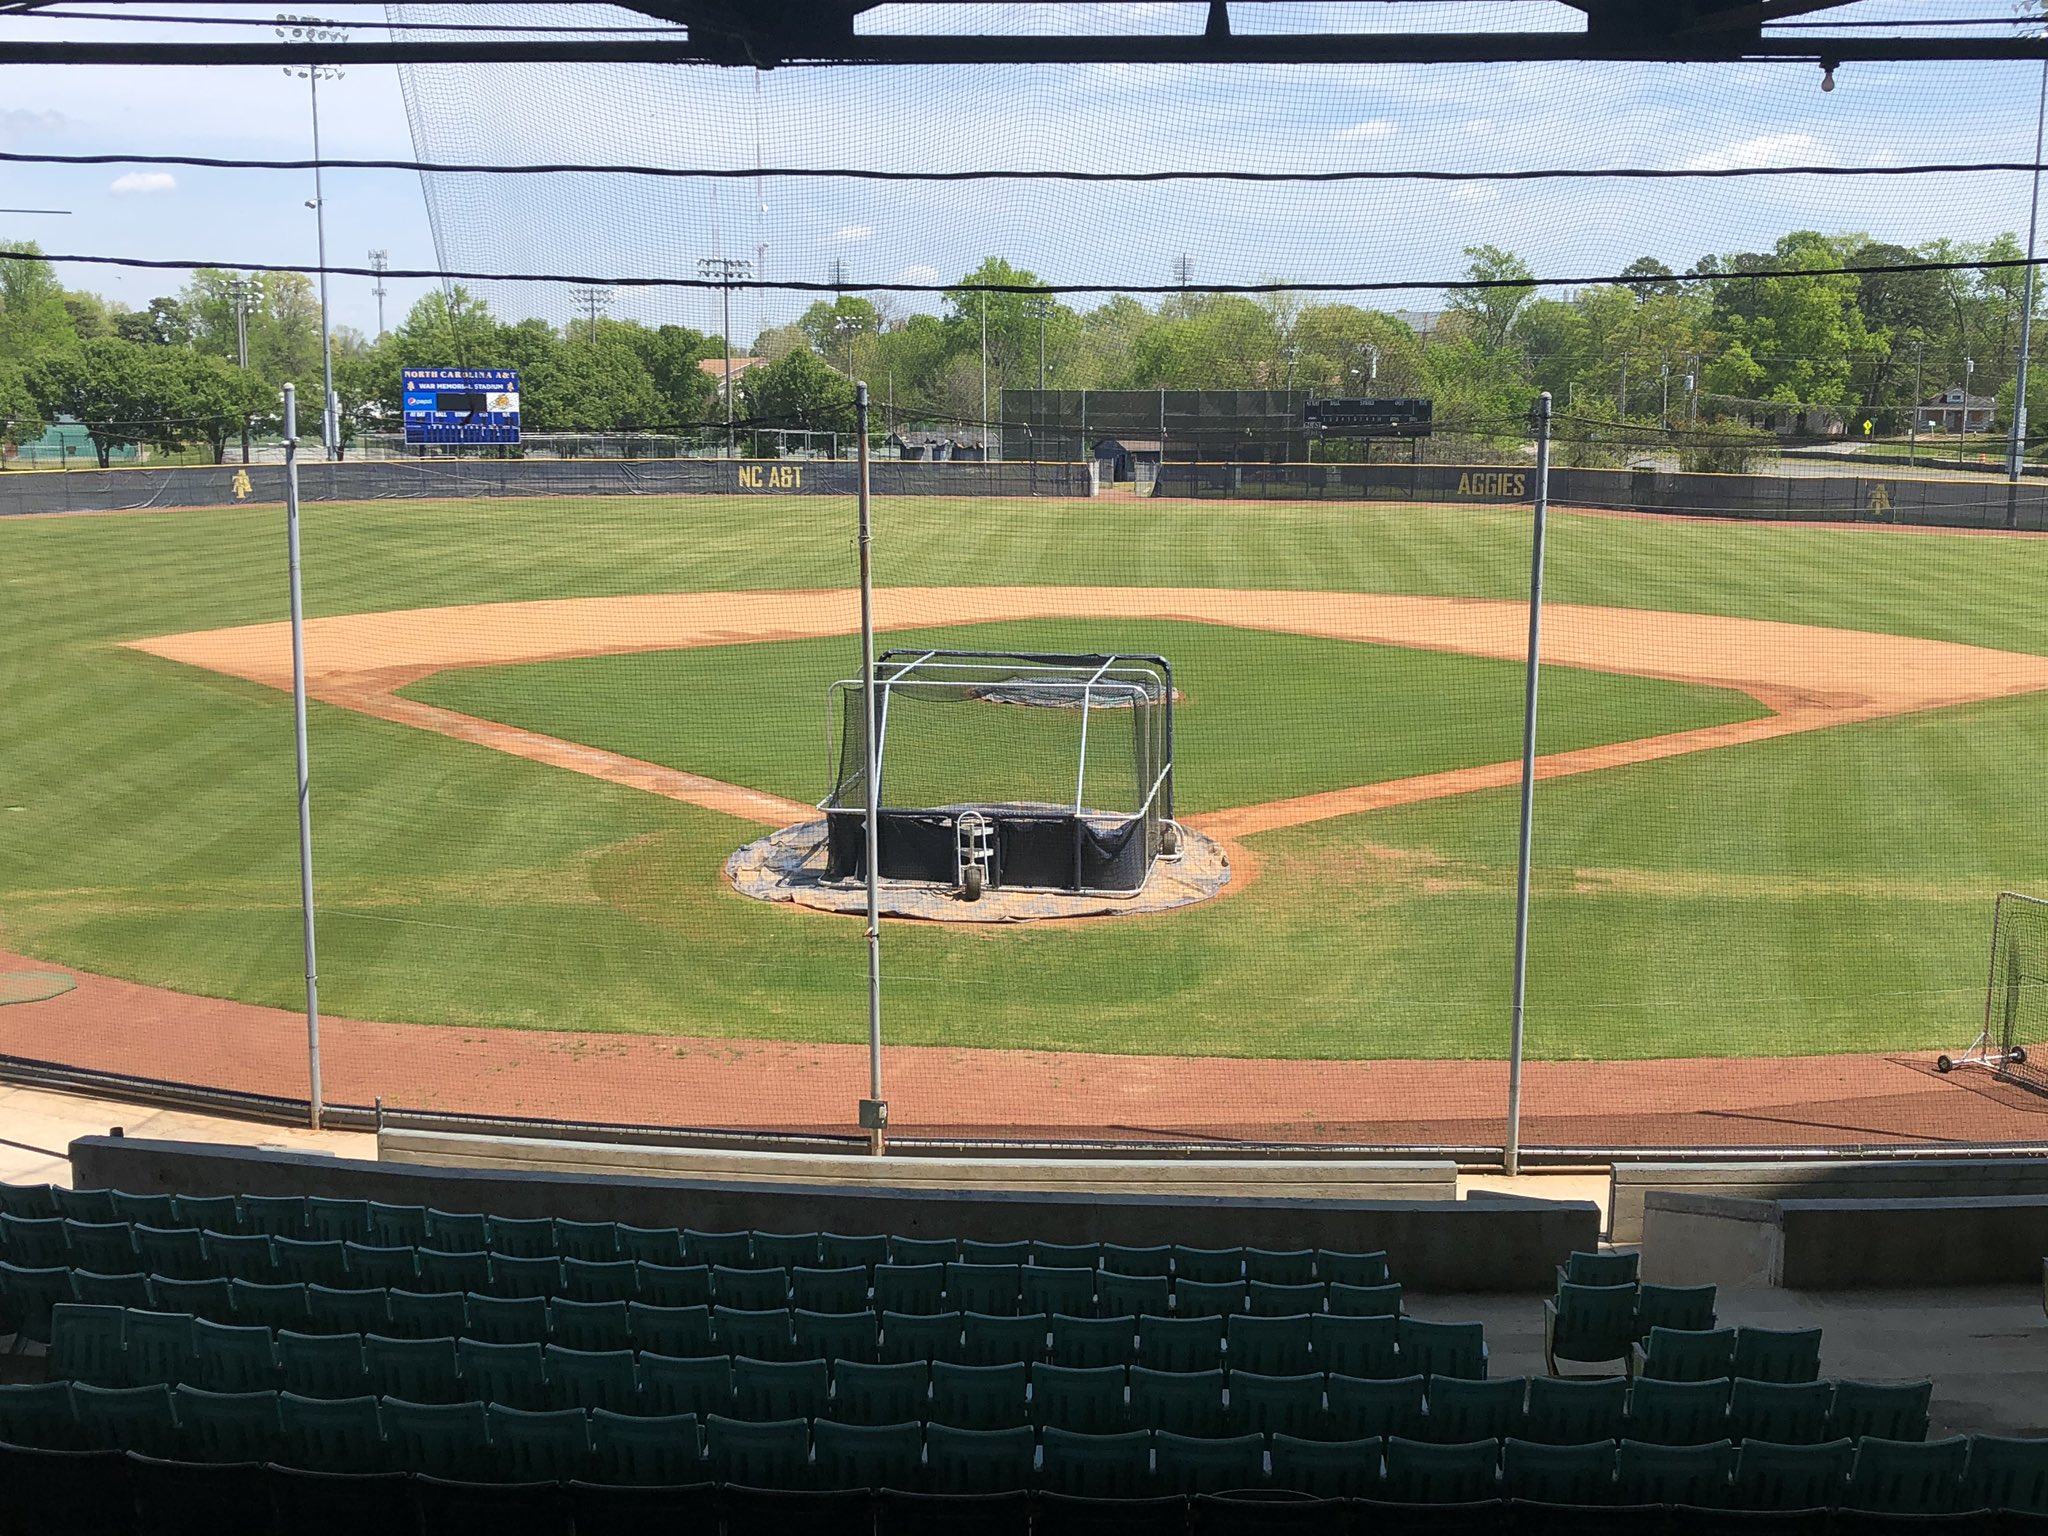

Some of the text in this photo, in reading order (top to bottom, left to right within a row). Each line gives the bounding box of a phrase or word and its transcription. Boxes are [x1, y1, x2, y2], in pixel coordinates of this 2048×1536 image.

[440, 371, 492, 379] CAROLINA
[495, 371, 517, 379] A&T
[739, 465, 803, 488] NC A&T
[1457, 472, 1526, 496] AGGIES
